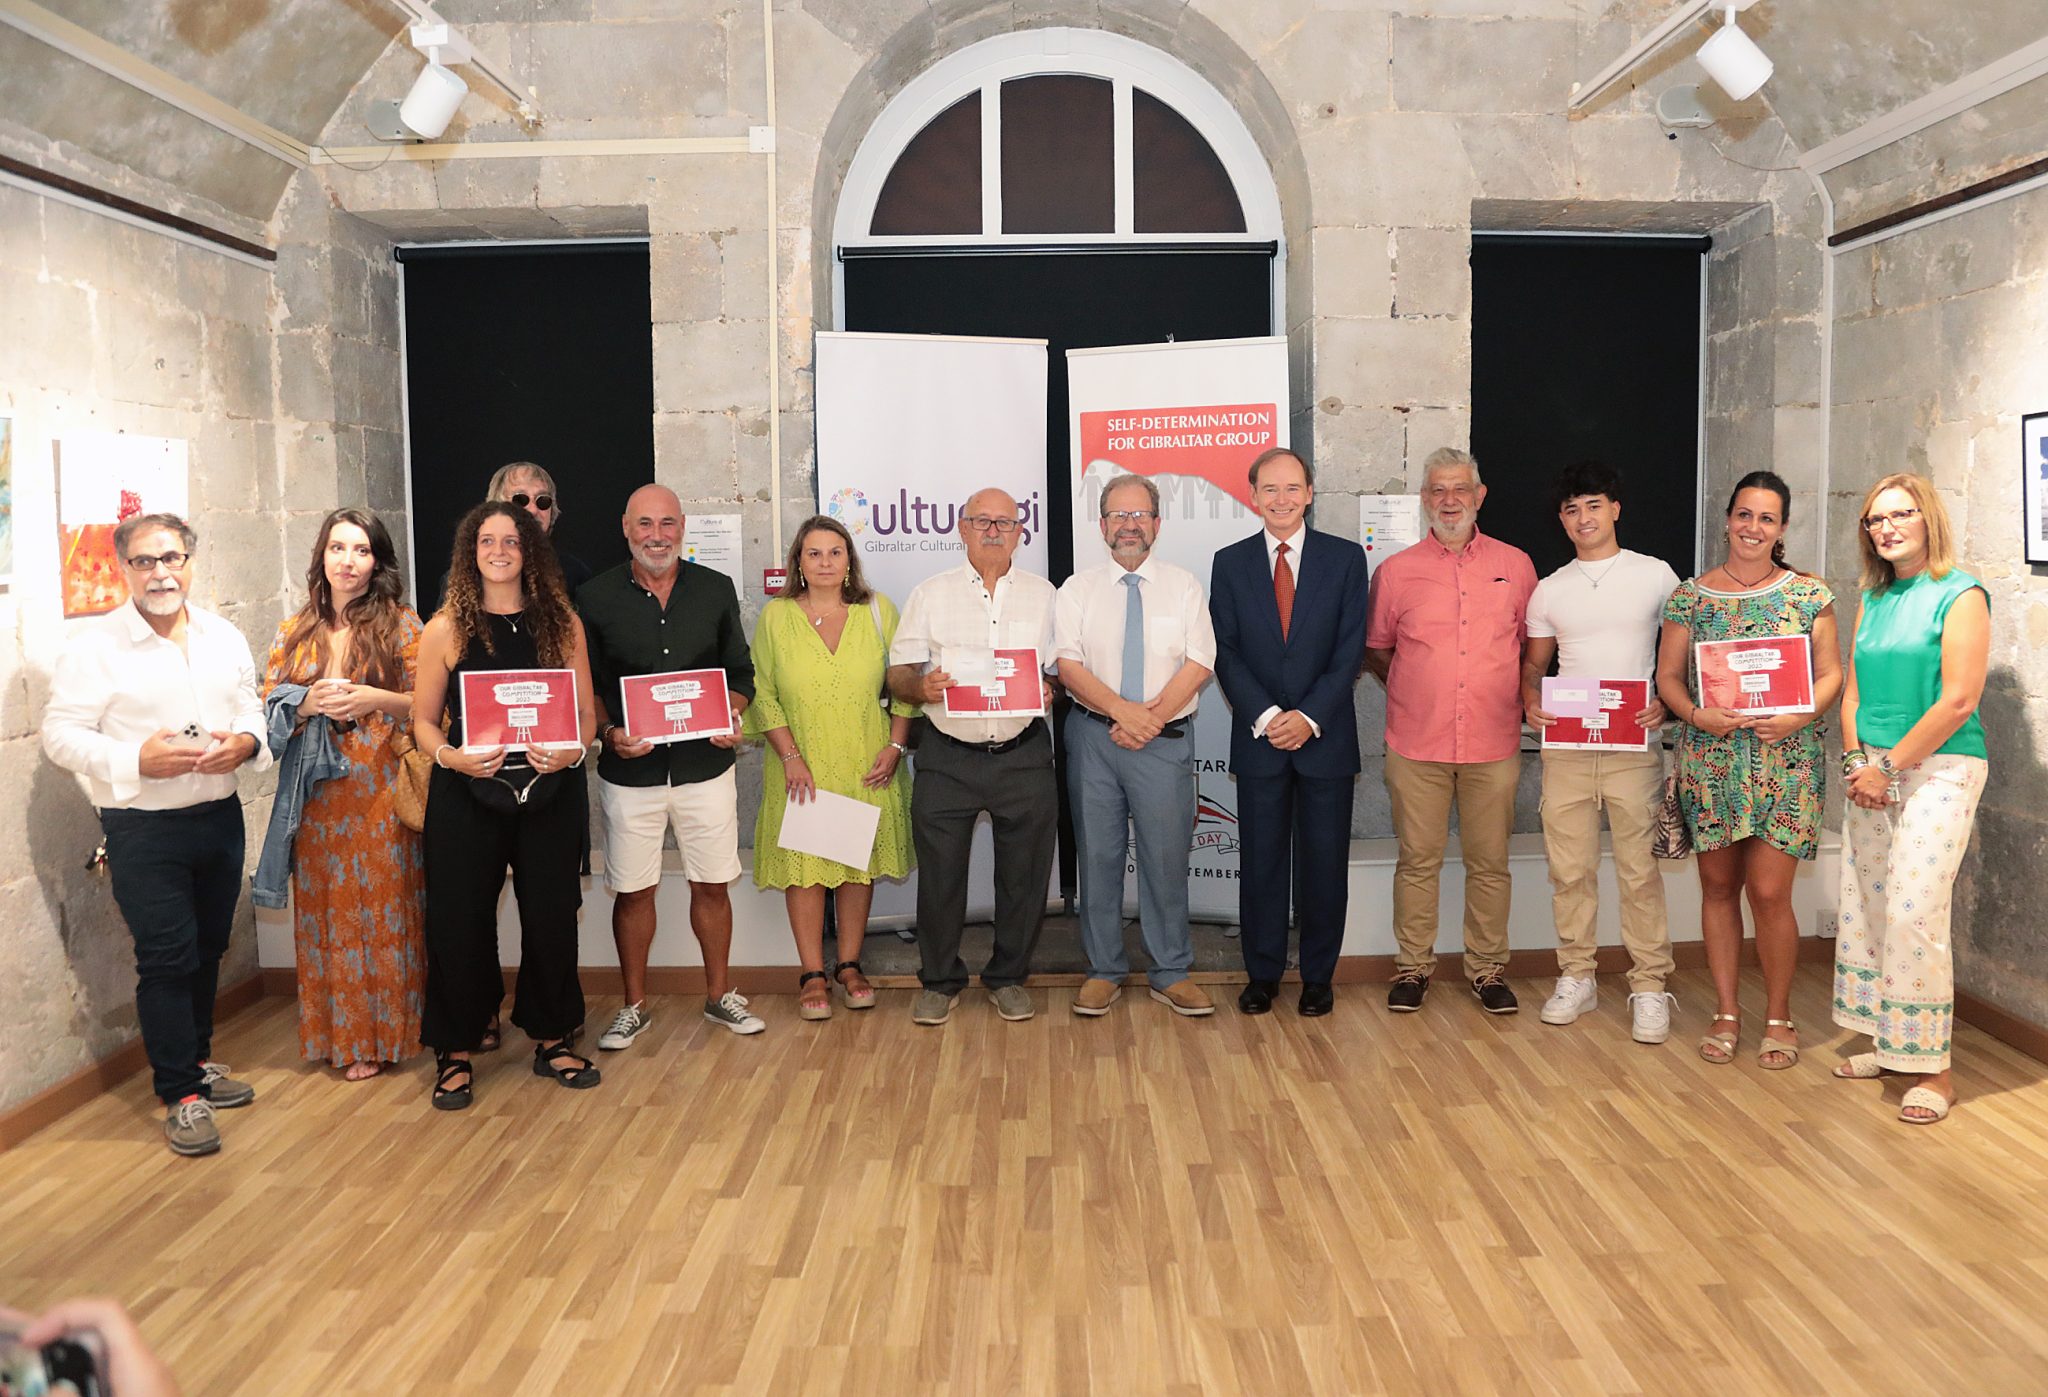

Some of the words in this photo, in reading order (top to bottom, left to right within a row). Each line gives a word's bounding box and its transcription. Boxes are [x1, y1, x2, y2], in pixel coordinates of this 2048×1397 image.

[1107, 411, 1270, 432] SELF-DETERMINATION
[1107, 437, 1135, 451] FOR
[1138, 433, 1213, 449] GIBRALTAR
[1215, 431, 1271, 446] GROUP
[864, 540, 917, 553] Gibraltar
[1197, 833, 1223, 846] DAY
[1187, 867, 1240, 879] TEMBER
